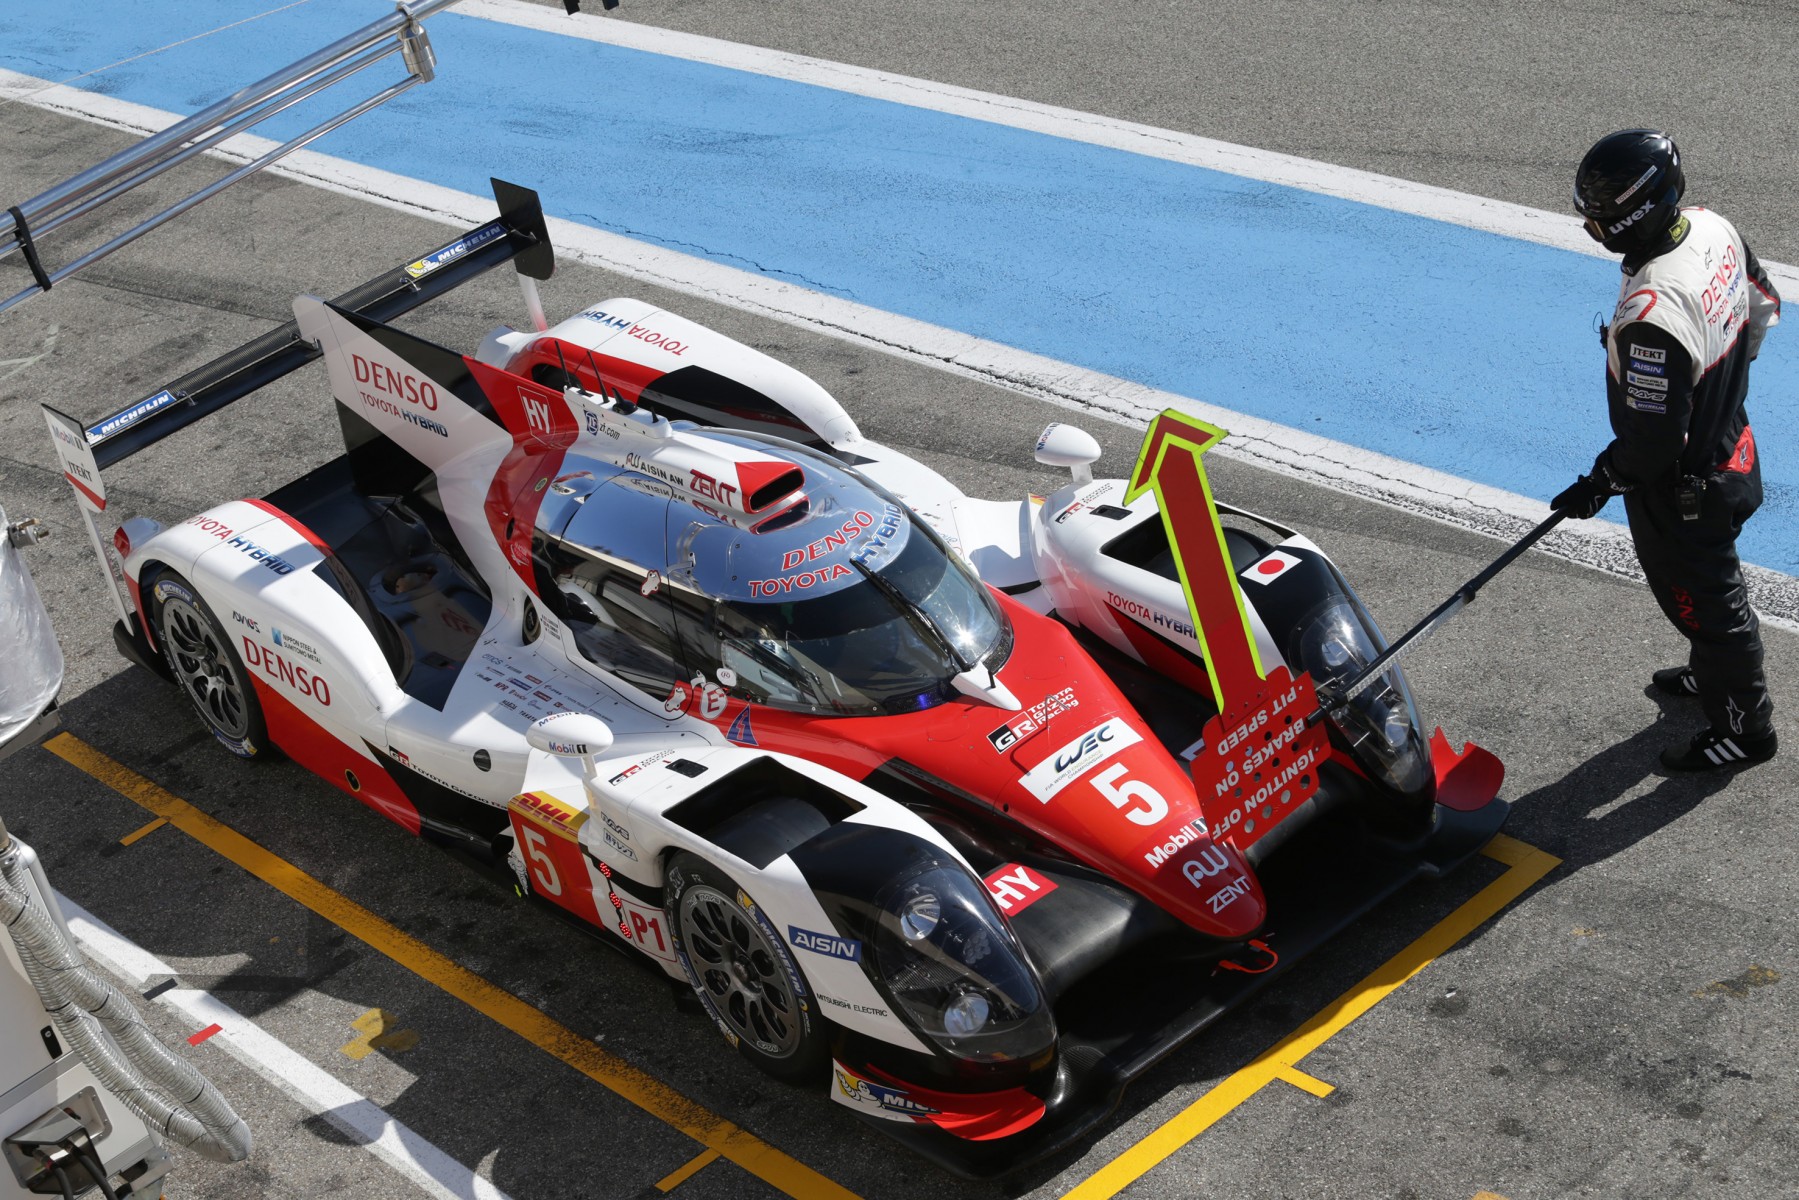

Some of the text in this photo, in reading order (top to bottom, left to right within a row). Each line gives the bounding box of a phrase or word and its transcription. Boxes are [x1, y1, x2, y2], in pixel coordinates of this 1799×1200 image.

[1608, 200, 1656, 234] uvex
[438, 226, 501, 262] MICHELIN
[1701, 245, 1737, 316] DENSO
[627, 325, 689, 356] TOYOTA
[1632, 347, 1664, 359] JTEKT
[352, 354, 438, 411] DENSO
[1633, 362, 1662, 373] AISIN
[1628, 386, 1667, 401] RAYS
[101, 394, 169, 434] MICHELIN
[360, 392, 448, 438] TOYOTA HYBRID
[522, 396, 551, 434] HY
[67, 461, 93, 482] JTEKT
[640, 461, 667, 480] AISIN
[669, 473, 684, 487] AW
[690, 469, 737, 508] ZENT
[227, 535, 296, 575] HYBRID
[748, 503, 903, 598] TOYOTA HYBRID
[781, 511, 875, 571] DENSO
[1107, 591, 1151, 621] TOYOTA
[282, 633, 300, 647] NIPPON
[299, 641, 313, 653] STEEL
[242, 635, 331, 706] DENSO
[707, 688, 724, 713] E
[1027, 686, 1074, 714] TOYOTA
[1032, 693, 1075, 720] GAZOO
[1037, 699, 1080, 725] Racing
[994, 719, 1036, 752] GR
[1217, 686, 1298, 756] PIT SPEED
[548, 742, 576, 754] Mobil
[1054, 724, 1115, 774] WEC
[1215, 718, 1306, 797] BRAKES ON
[411, 764, 450, 788] TOYOTA
[450, 784, 490, 806] GAZOO
[1089, 762, 1169, 827] 5
[1211, 749, 1315, 840] IGNITION OFF
[517, 792, 572, 834] DHL
[522, 824, 562, 897] 5
[1144, 817, 1208, 869] Mobil 1
[992, 866, 1041, 910] HY
[1205, 876, 1251, 915] ZENT
[629, 910, 667, 952] P1
[794, 932, 856, 958] AISIN
[760, 922, 802, 993] MICHELIN
[816, 993, 888, 1017] MITSUBISHI ELECTRIC
